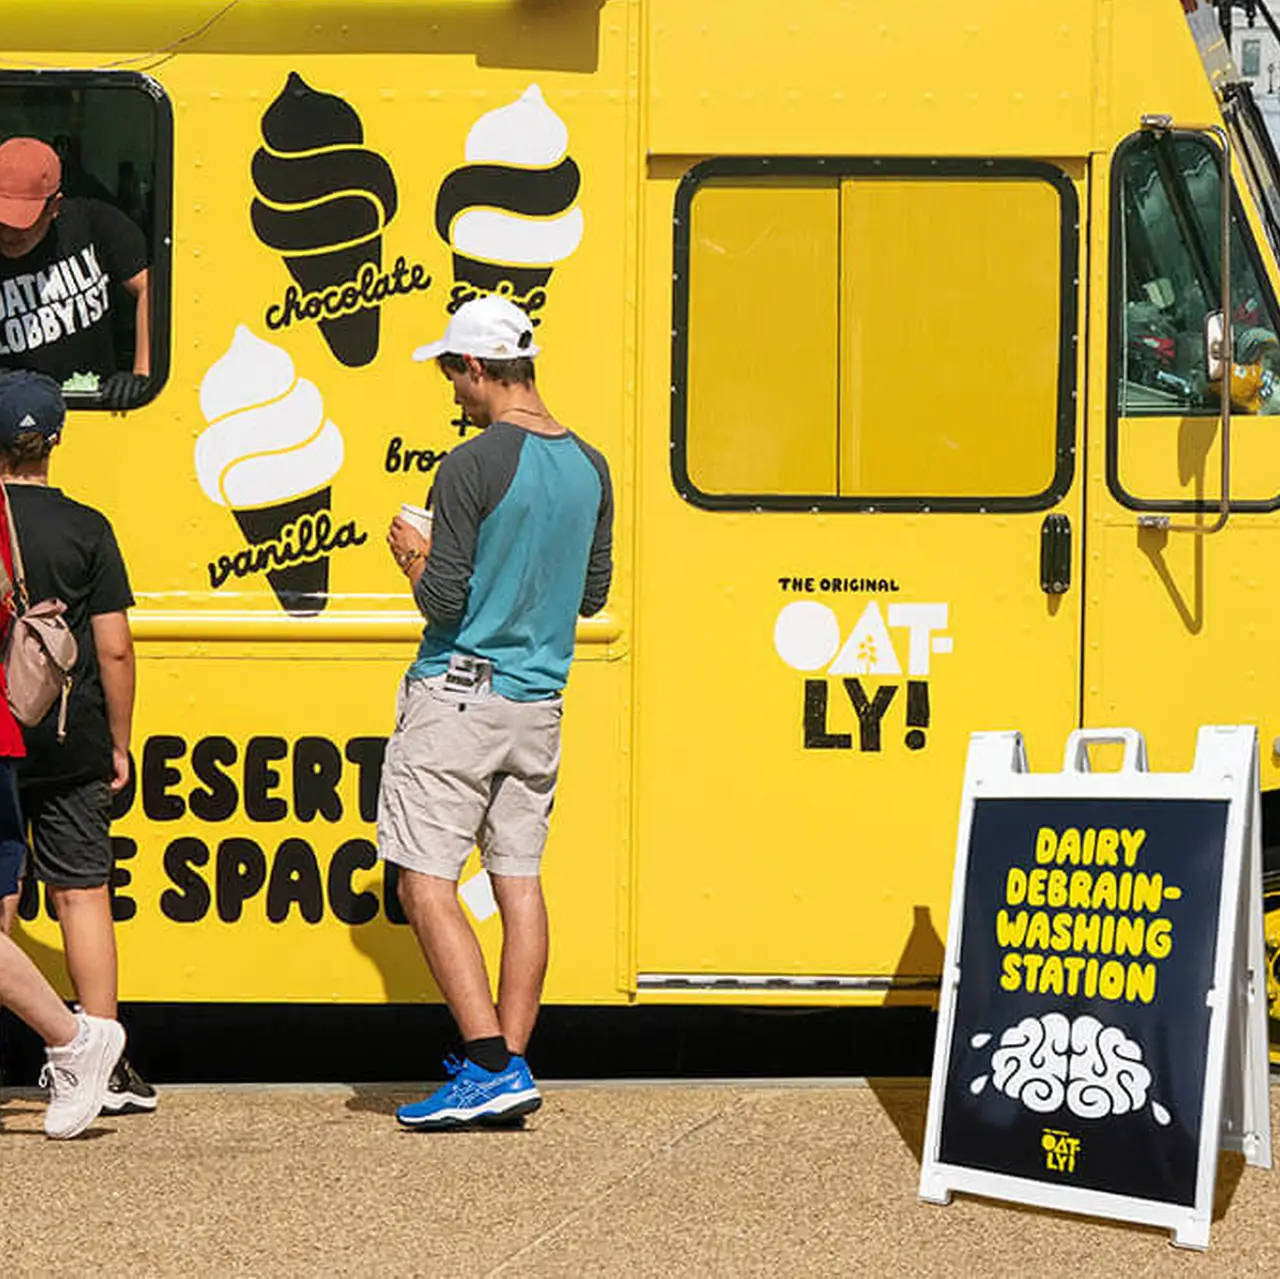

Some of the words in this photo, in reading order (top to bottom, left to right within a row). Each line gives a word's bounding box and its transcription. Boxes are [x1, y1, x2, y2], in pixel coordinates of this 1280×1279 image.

[265, 256, 432, 331] chocolate
[208, 515, 368, 589] vanilla
[778, 578, 815, 592] THE
[820, 578, 900, 592] ORIGINAL
[804, 677, 930, 751] LY!
[1036, 827, 1146, 866] DAIRY
[1006, 867, 1182, 912] DEBRAIN-
[996, 909, 1172, 959] WASHING
[1000, 953, 1157, 1004] STATION
